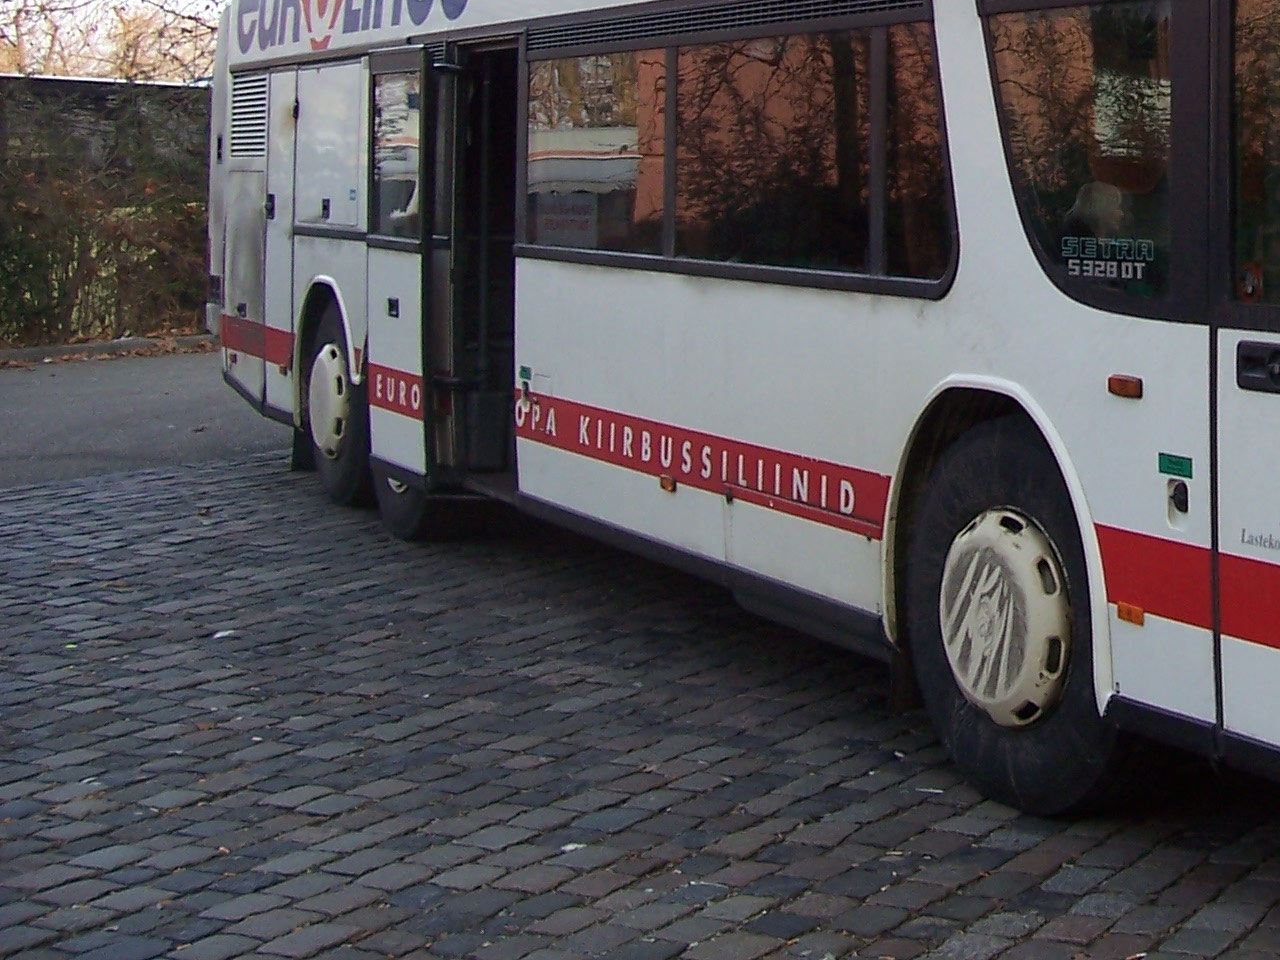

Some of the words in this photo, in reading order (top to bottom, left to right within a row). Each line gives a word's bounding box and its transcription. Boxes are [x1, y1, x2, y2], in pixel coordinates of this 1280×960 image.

[1061, 236, 1155, 261] SETRA
[375, 373, 421, 412] EURO
[578, 414, 857, 517] KIIRBUSSILIINID
